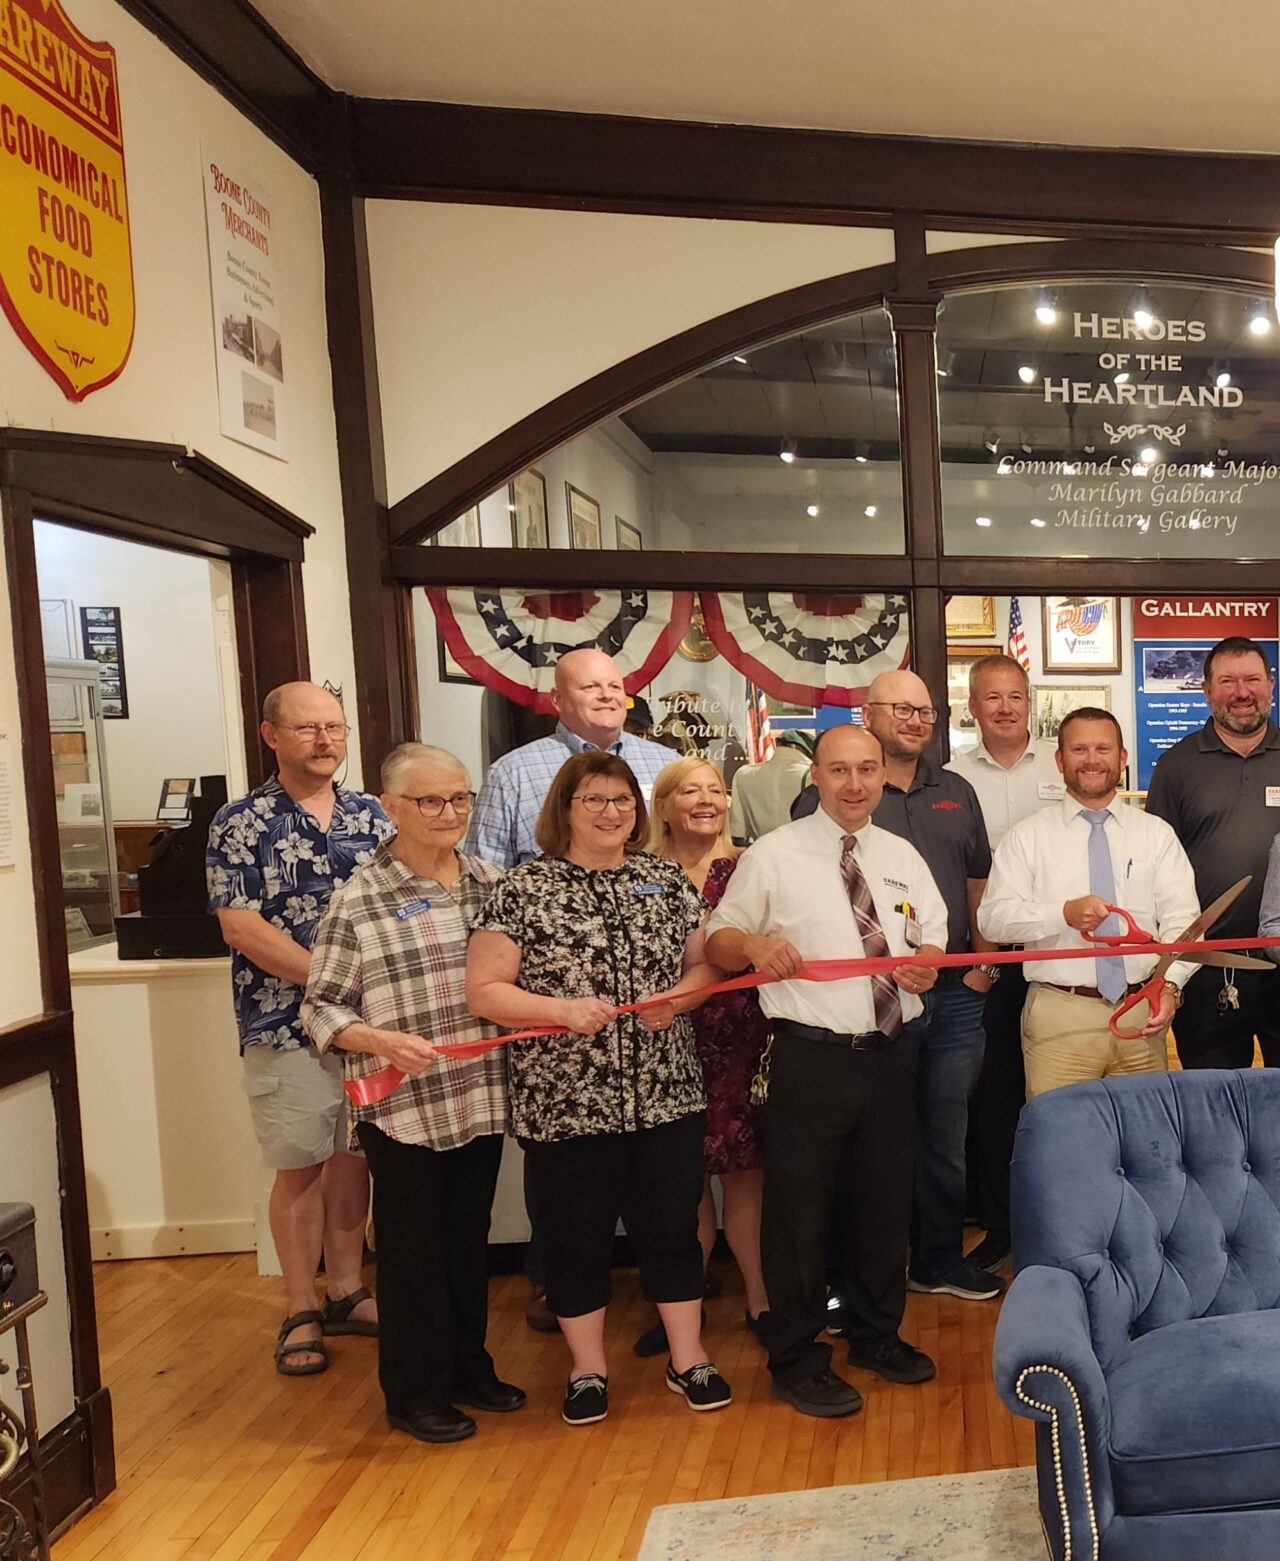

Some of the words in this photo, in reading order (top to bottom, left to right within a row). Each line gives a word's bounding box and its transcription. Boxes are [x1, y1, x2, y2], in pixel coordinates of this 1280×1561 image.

[0, 104, 123, 224] CONOMICAL
[210, 163, 242, 205] BOONE
[243, 188, 271, 229] COUNTY
[38, 186, 92, 258] FOOD
[221, 202, 269, 256] MERCHANTS
[28, 245, 109, 327] STORES
[1073, 312, 1206, 342] HEROES
[1099, 353, 1130, 369] OF
[1136, 354, 1182, 371] THE
[1044, 377, 1243, 408] HEARTLAND
[997, 455, 1116, 477] Command
[1119, 458, 1216, 483] Sergeant
[1048, 483, 1144, 508] Marilyn
[1151, 483, 1249, 507] Gabbard
[1055, 507, 1151, 534] Military
[1159, 508, 1238, 536] Gallery
[1141, 599, 1270, 617] GALLANTRY
